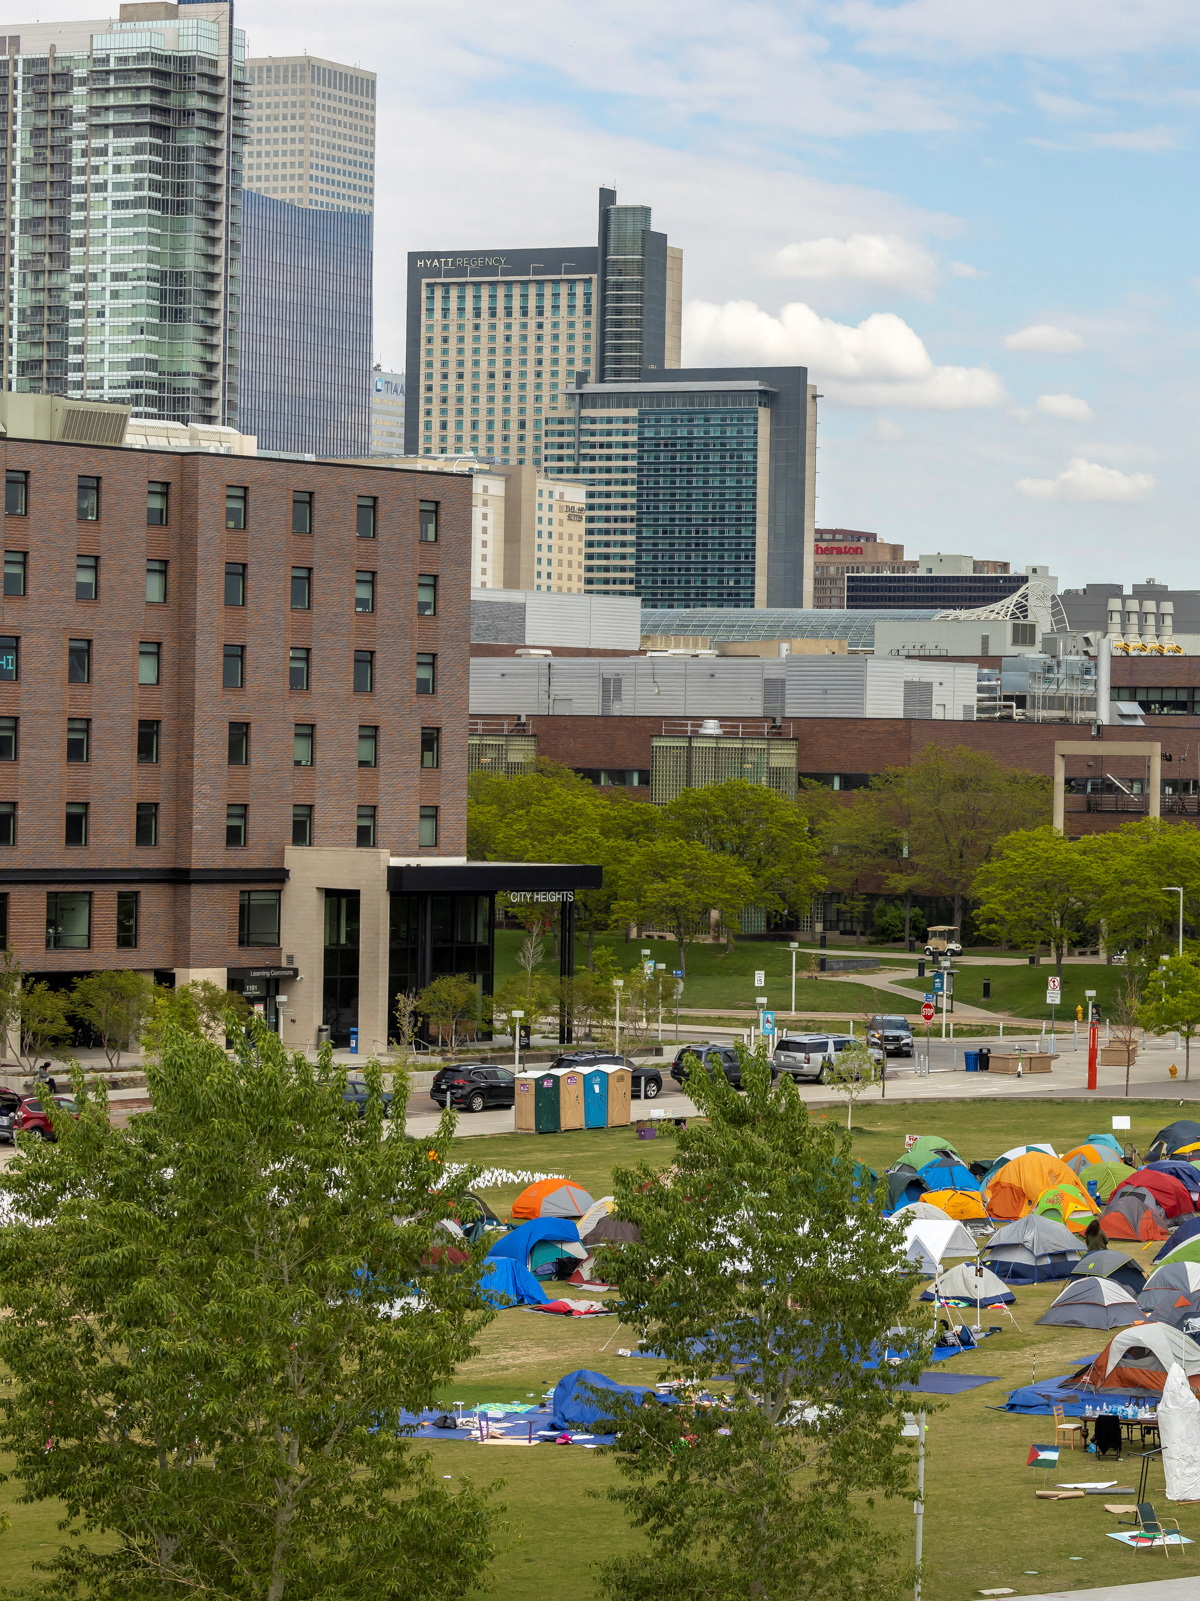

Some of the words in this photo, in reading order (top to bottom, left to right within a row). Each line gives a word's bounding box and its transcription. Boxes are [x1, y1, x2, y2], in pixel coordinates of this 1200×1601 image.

[417, 258, 454, 268] HYATT
[456, 256, 507, 267] REGENCY
[384, 380, 405, 396] TIAA
[814, 543, 864, 555] heraton
[510, 891, 532, 902] CITY
[533, 891, 574, 902] HEIGHTS
[922, 1008, 934, 1016] STOP
